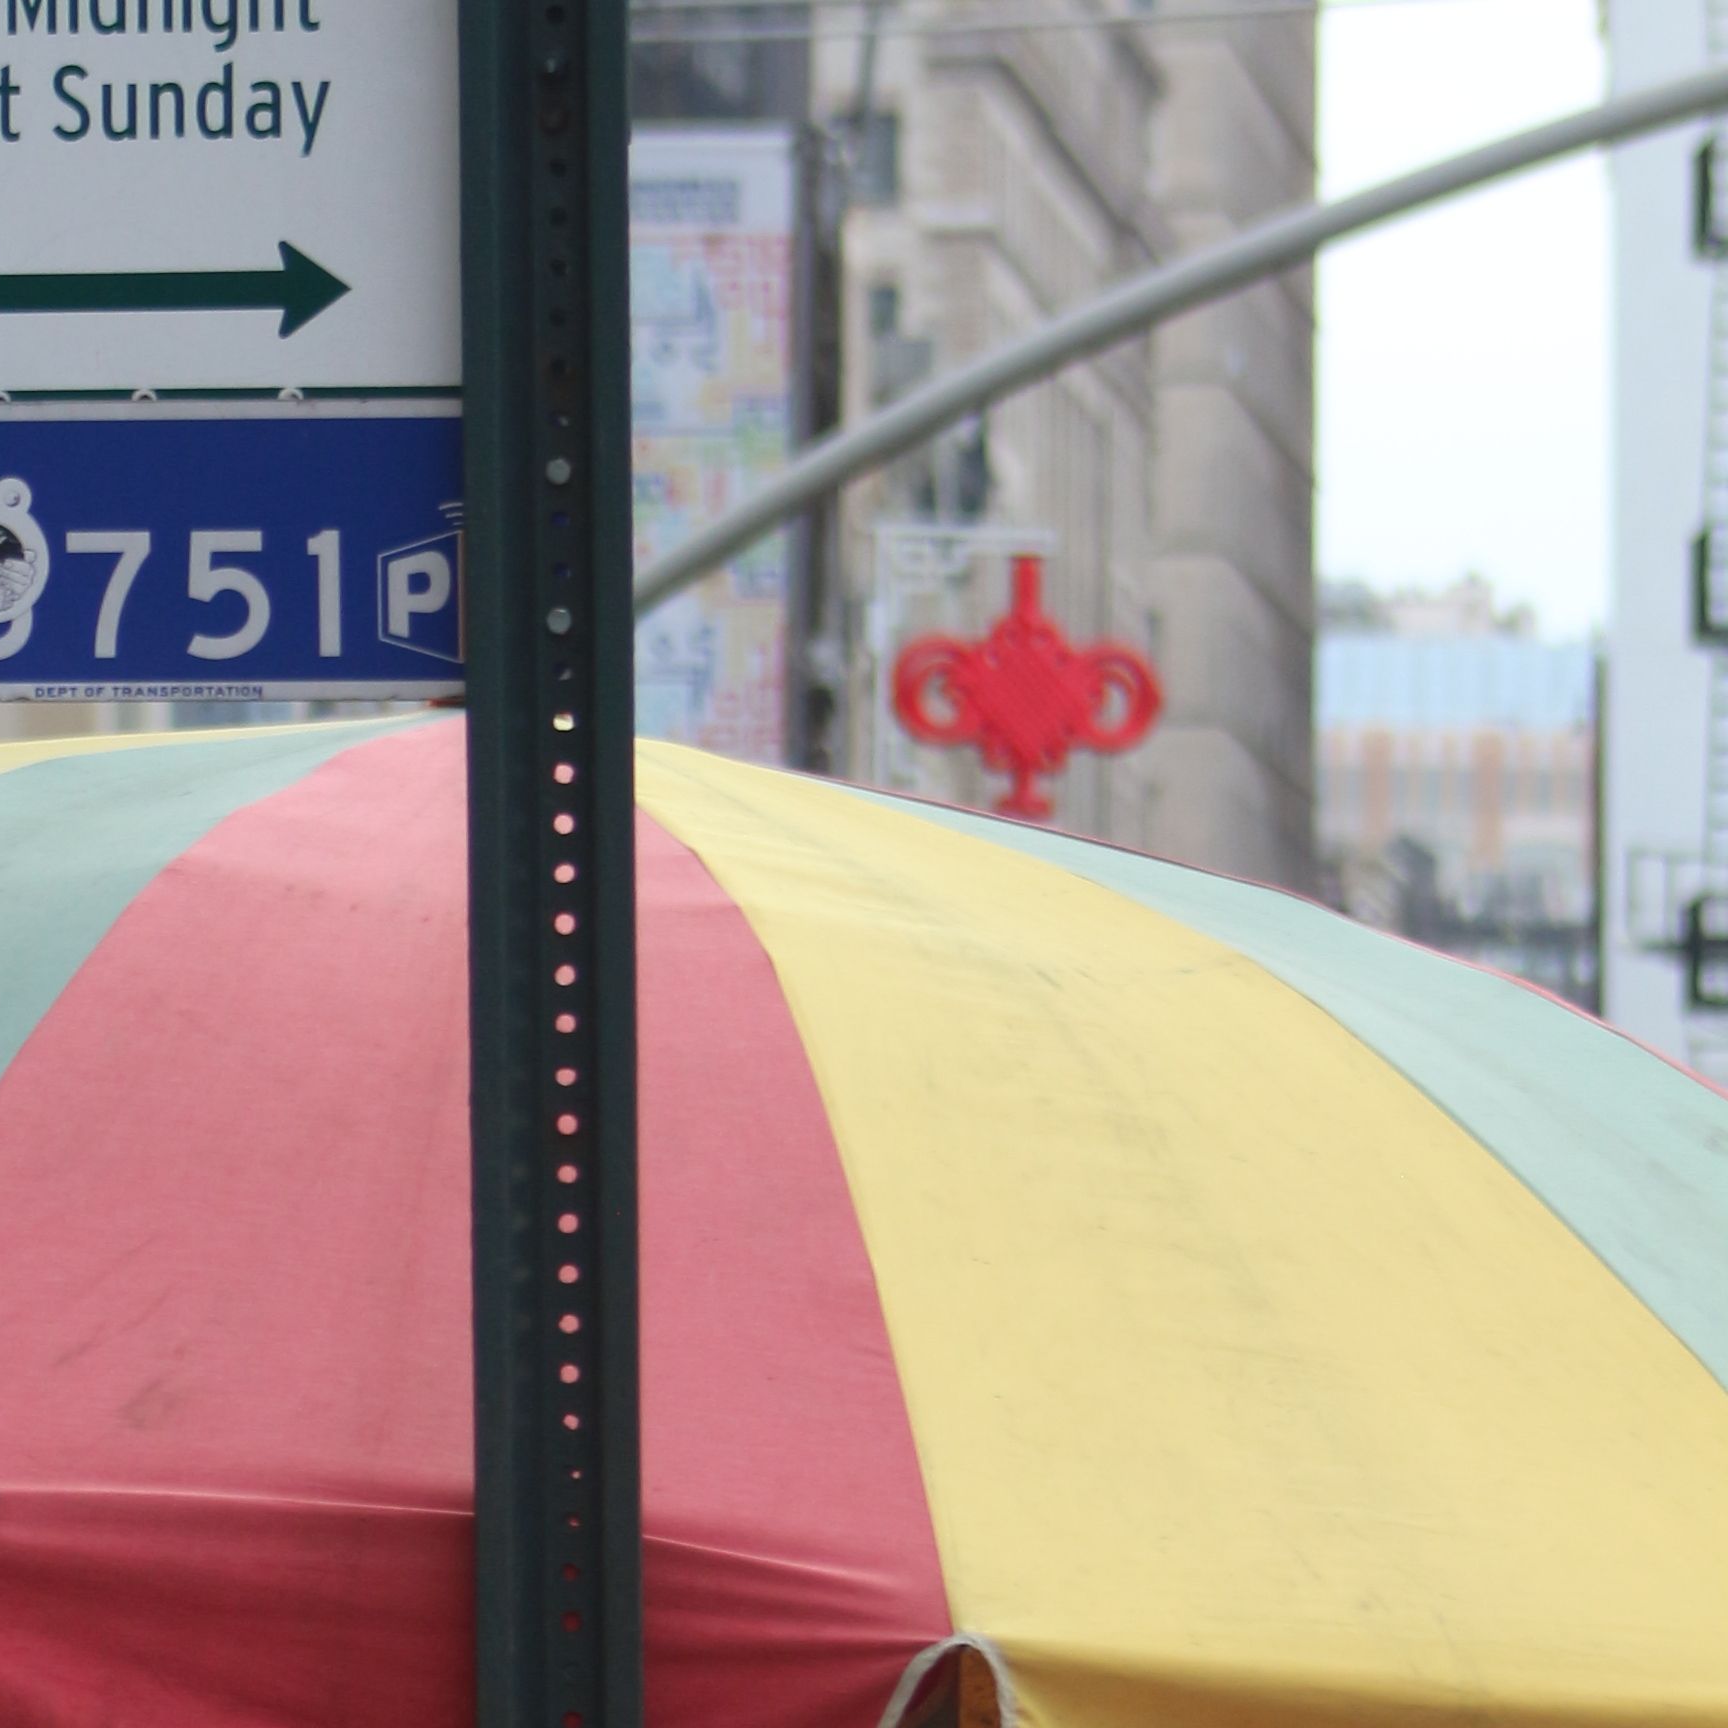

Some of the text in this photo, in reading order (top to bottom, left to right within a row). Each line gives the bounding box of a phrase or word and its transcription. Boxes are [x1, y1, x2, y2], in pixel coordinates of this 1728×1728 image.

[52, 62, 331, 158] Sunday
[35, 685, 263, 698] DEPT OF TRANSPORTATION
